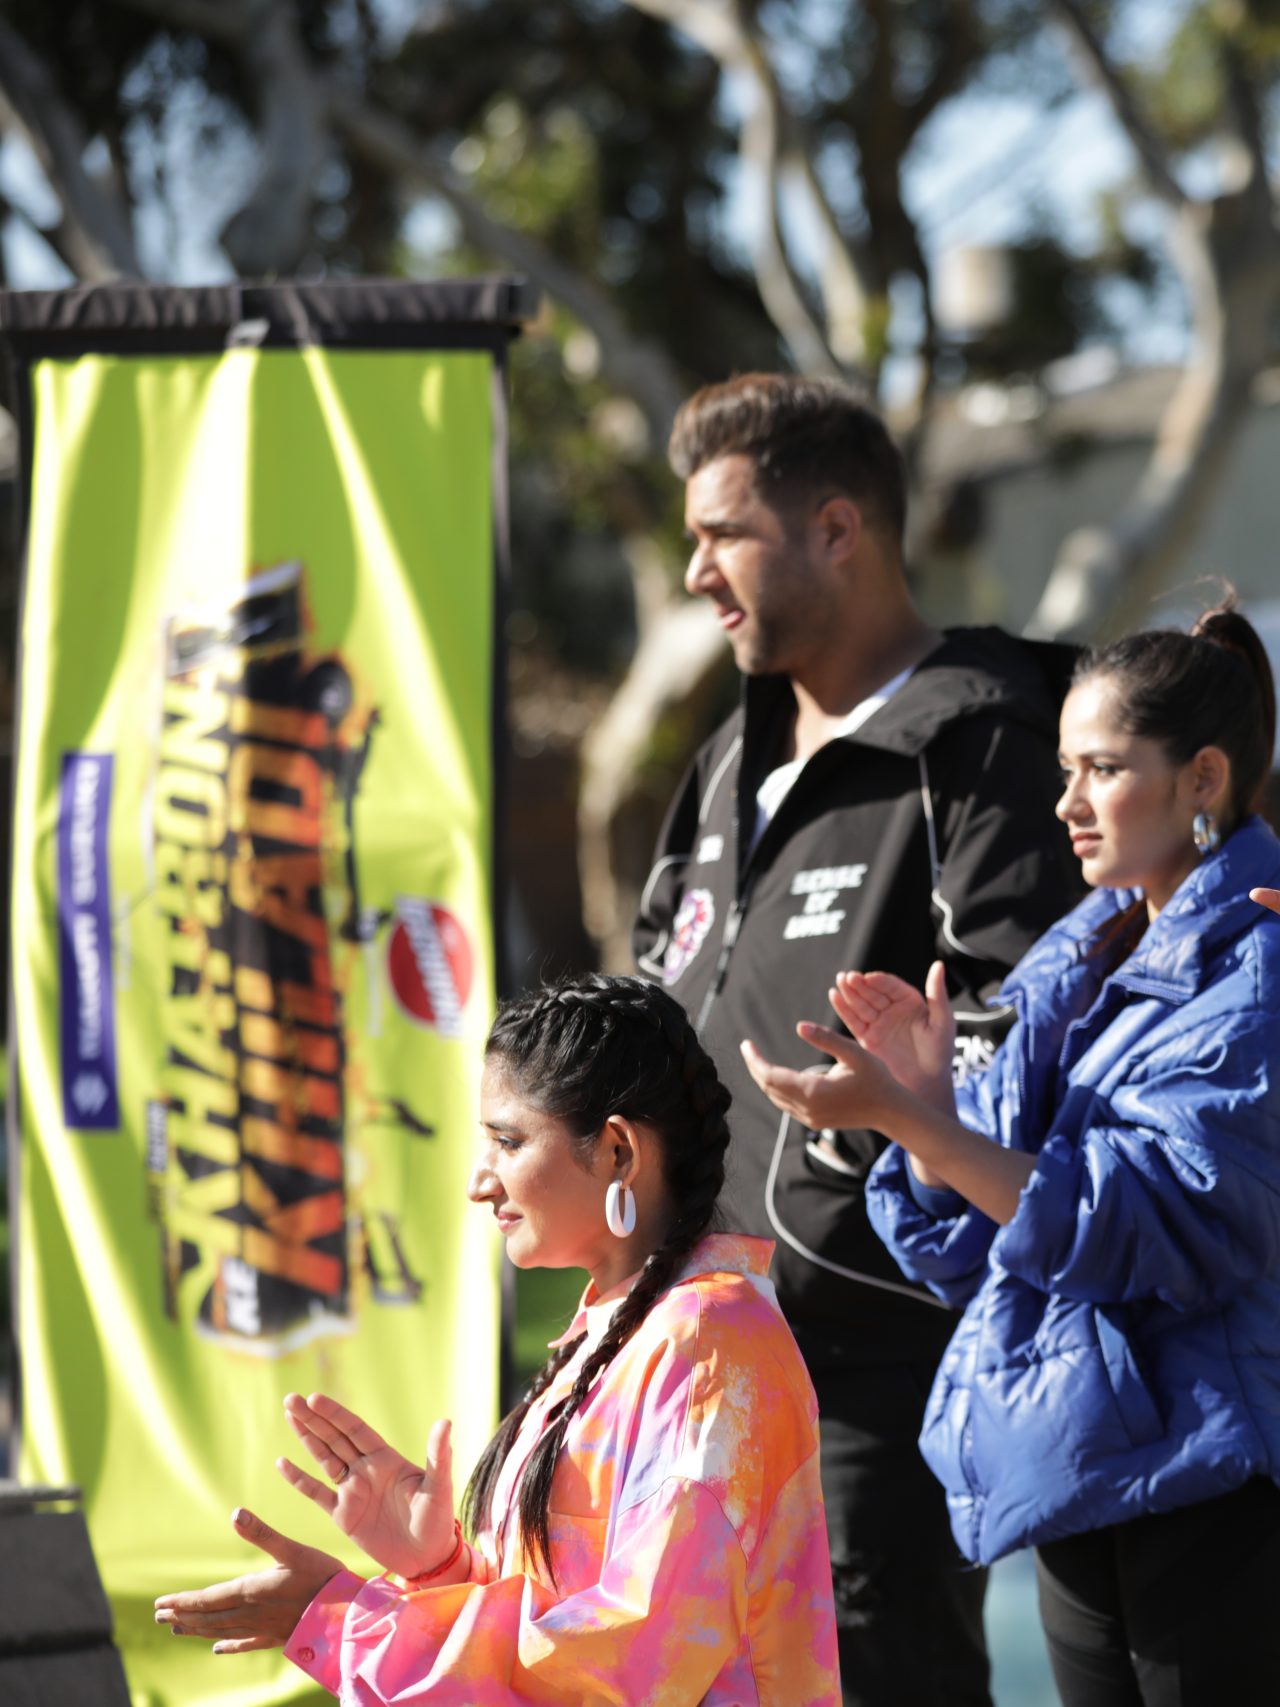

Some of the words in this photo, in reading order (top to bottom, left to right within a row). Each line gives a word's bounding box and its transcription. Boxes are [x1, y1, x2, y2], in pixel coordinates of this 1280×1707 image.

[154, 685, 240, 1260] KHATRON
[229, 697, 343, 1294] KHILADI
[223, 1257, 262, 1336] KE
